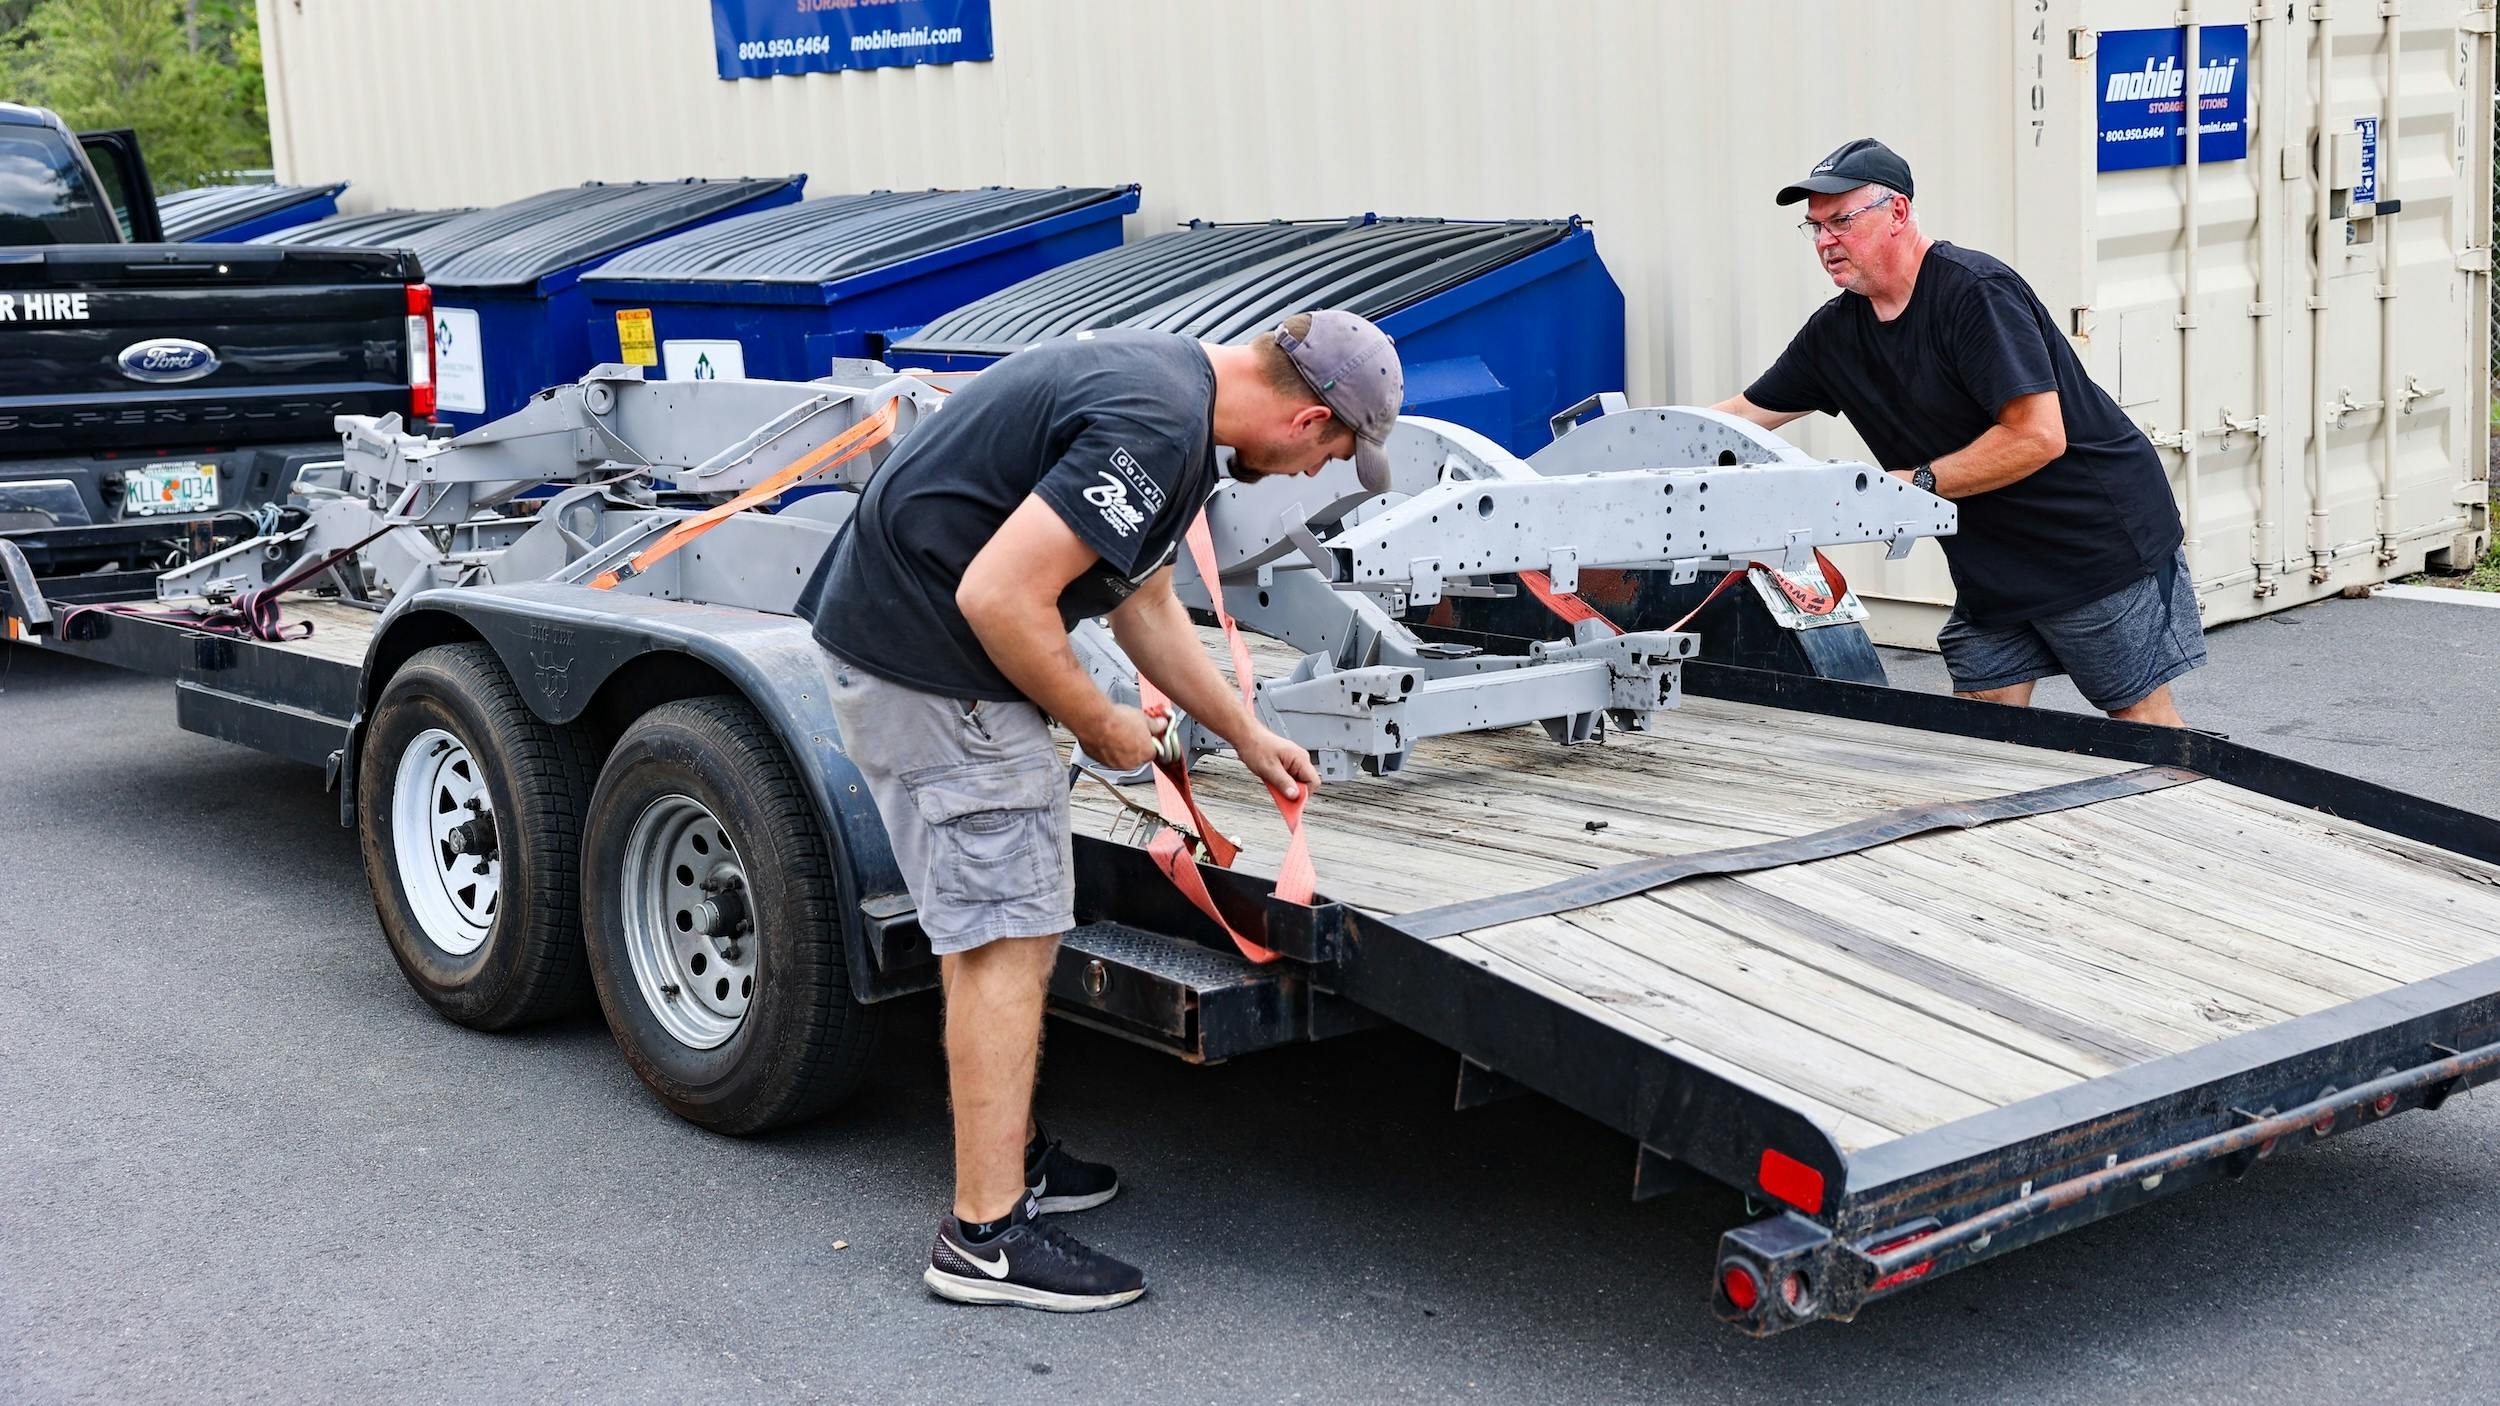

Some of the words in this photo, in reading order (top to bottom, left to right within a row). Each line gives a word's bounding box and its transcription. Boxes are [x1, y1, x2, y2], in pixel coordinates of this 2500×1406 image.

[738, 35, 830, 61] 800.950.6464
[851, 25, 962, 52] mobilemini.com
[2105, 55, 2184, 102] mobile
[2148, 101, 2184, 114] STORAGE
[2198, 97, 2228, 111] UTIONS
[2105, 126, 2165, 143] 800.950.6464
[2176, 121, 2238, 136] memini.com
[23, 292, 90, 321] HIRE
[143, 346, 194, 369] Ford
[127, 480, 160, 503] KLL
[1117, 455, 1162, 508] Garrett
